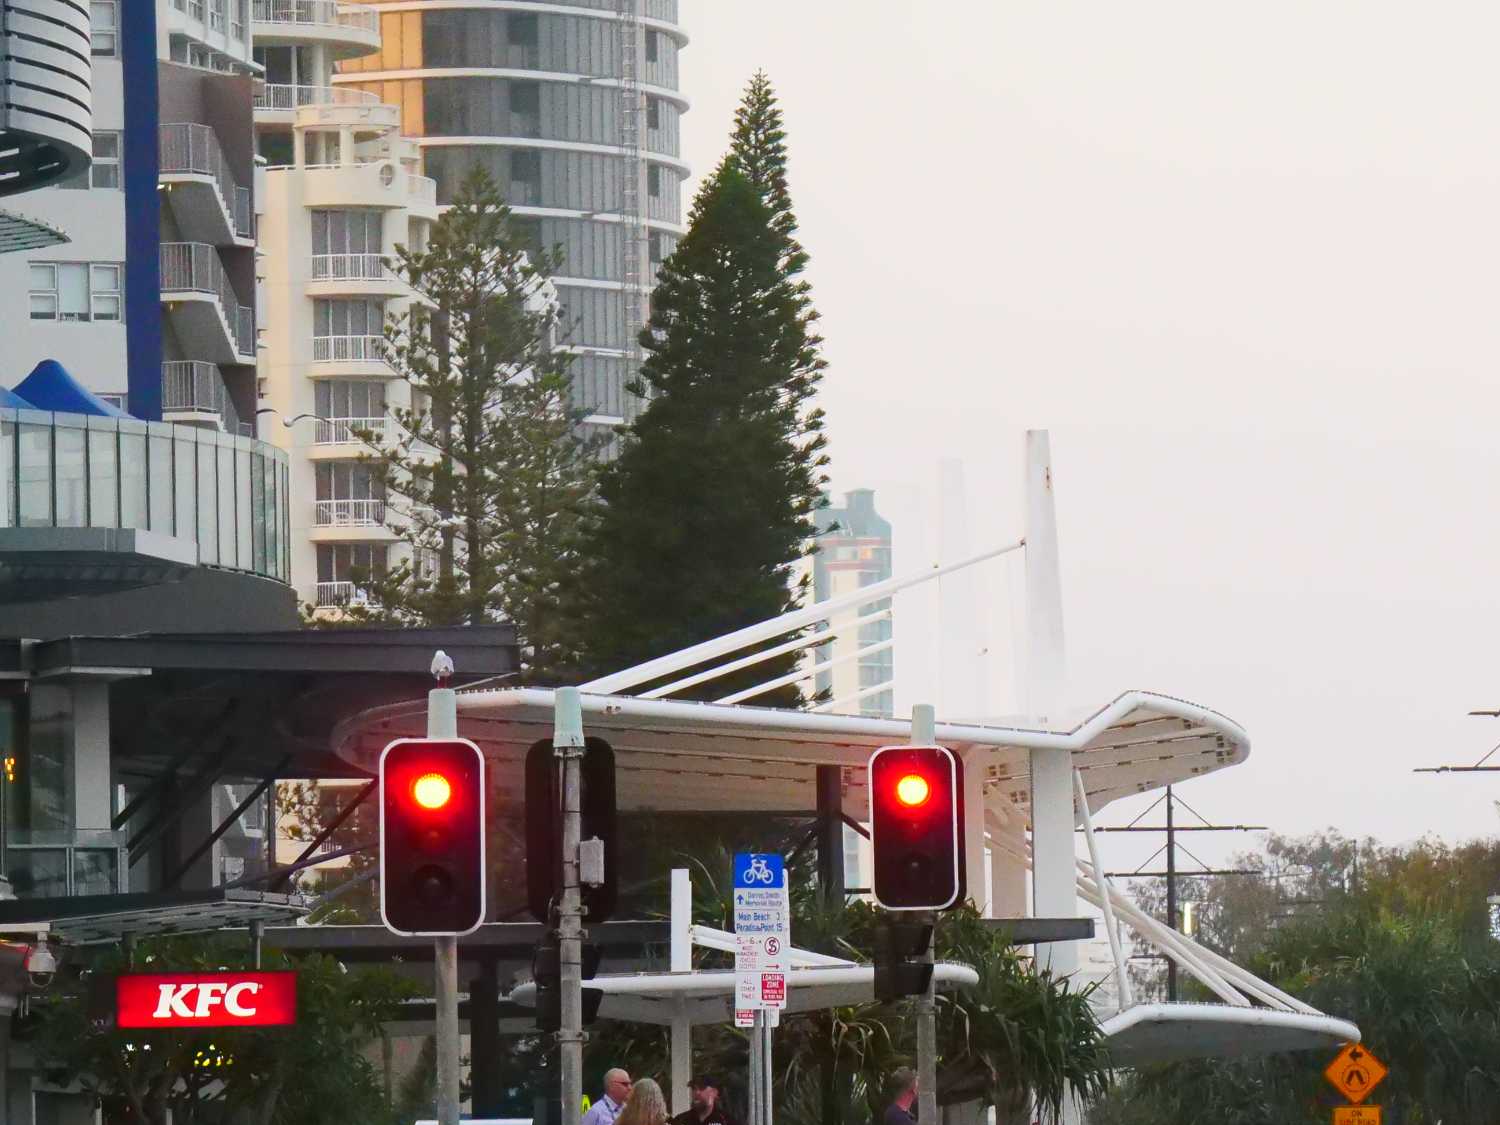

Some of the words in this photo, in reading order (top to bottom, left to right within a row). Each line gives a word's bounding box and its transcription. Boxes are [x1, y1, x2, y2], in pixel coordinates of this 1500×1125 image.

[739, 911, 752, 921] Main
[753, 911, 771, 921] Beach
[152, 982, 259, 1018] KFC
